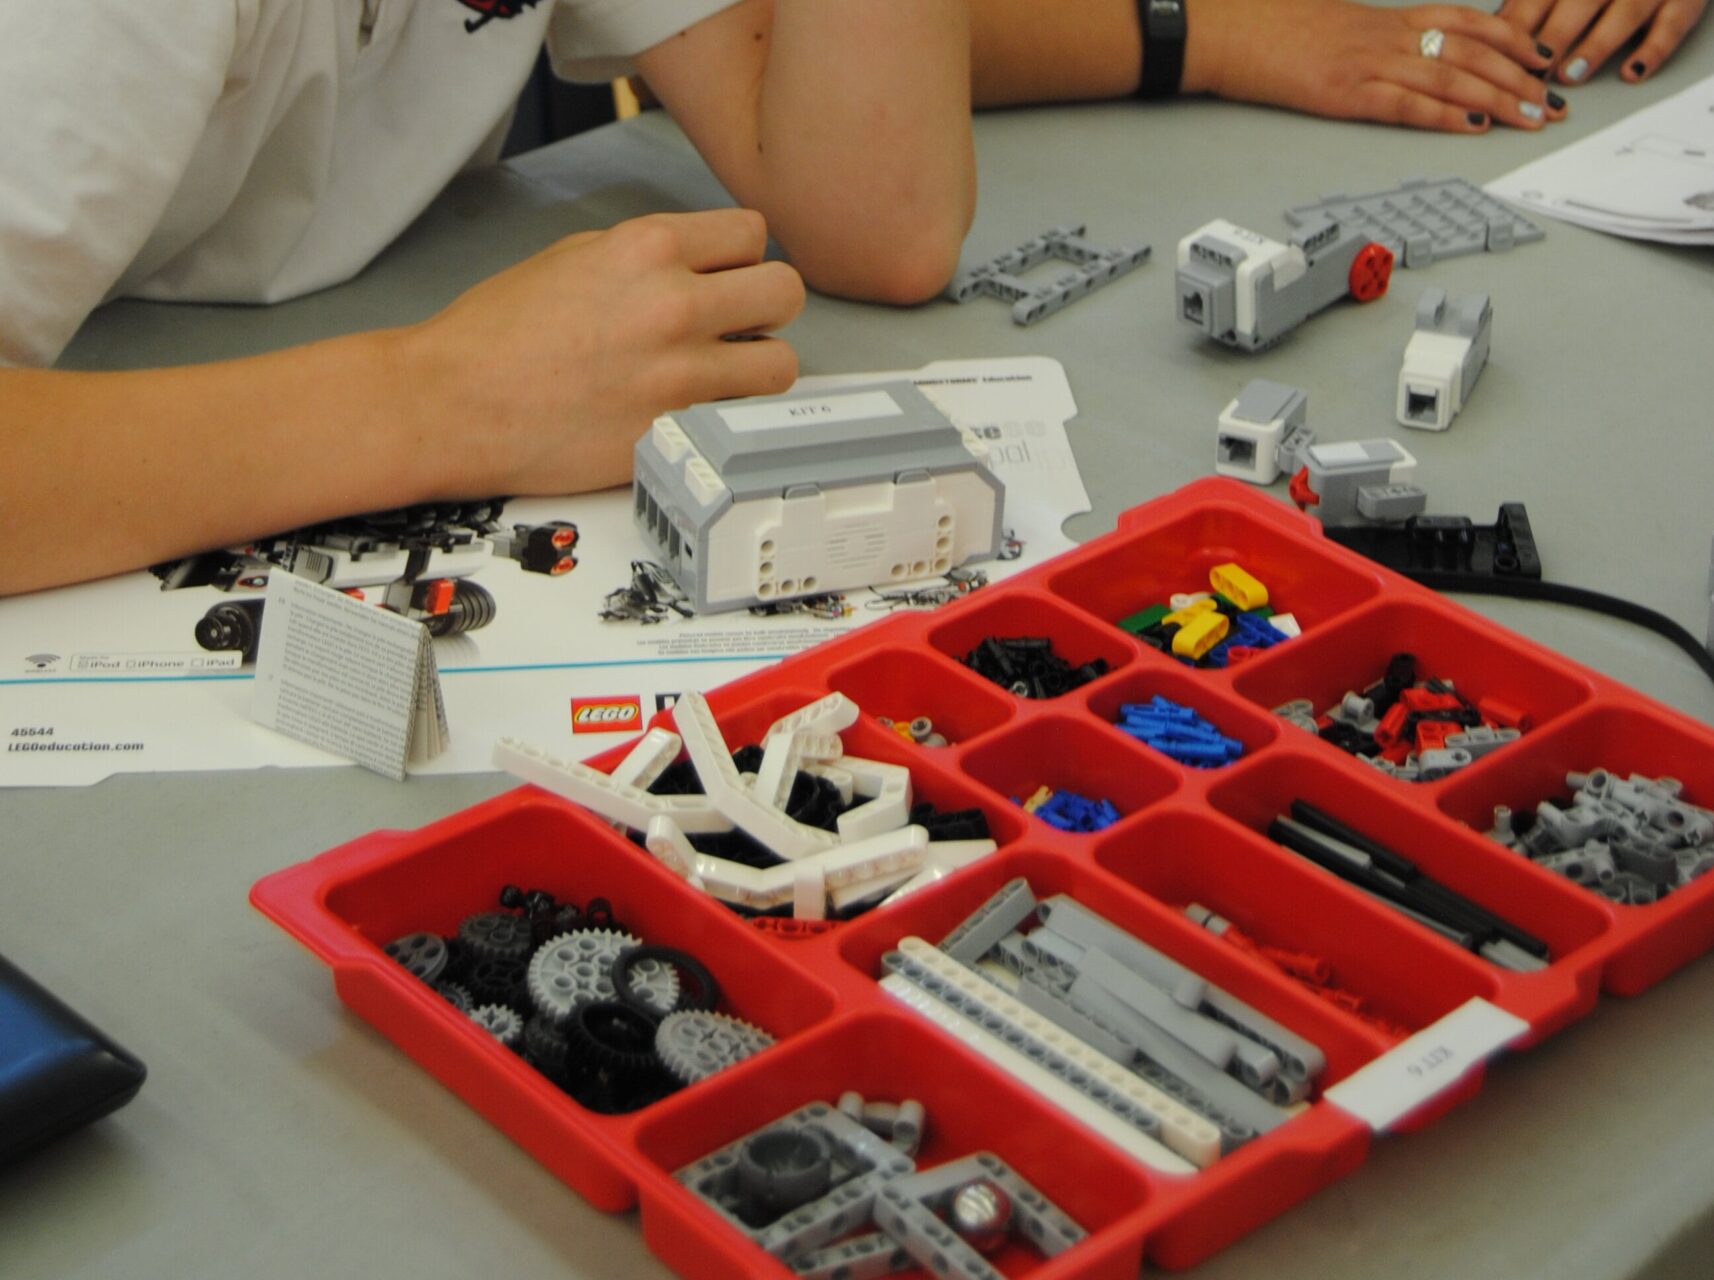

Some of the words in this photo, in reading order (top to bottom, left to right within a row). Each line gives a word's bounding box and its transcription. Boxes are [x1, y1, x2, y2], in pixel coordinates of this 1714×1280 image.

[137, 660, 184, 669] iPhone
[206, 658, 235, 667] iPad
[576, 704, 638, 723] LEGO
[11, 726, 54, 737] 45544
[8, 741, 144, 753] LEGOeducation.com
